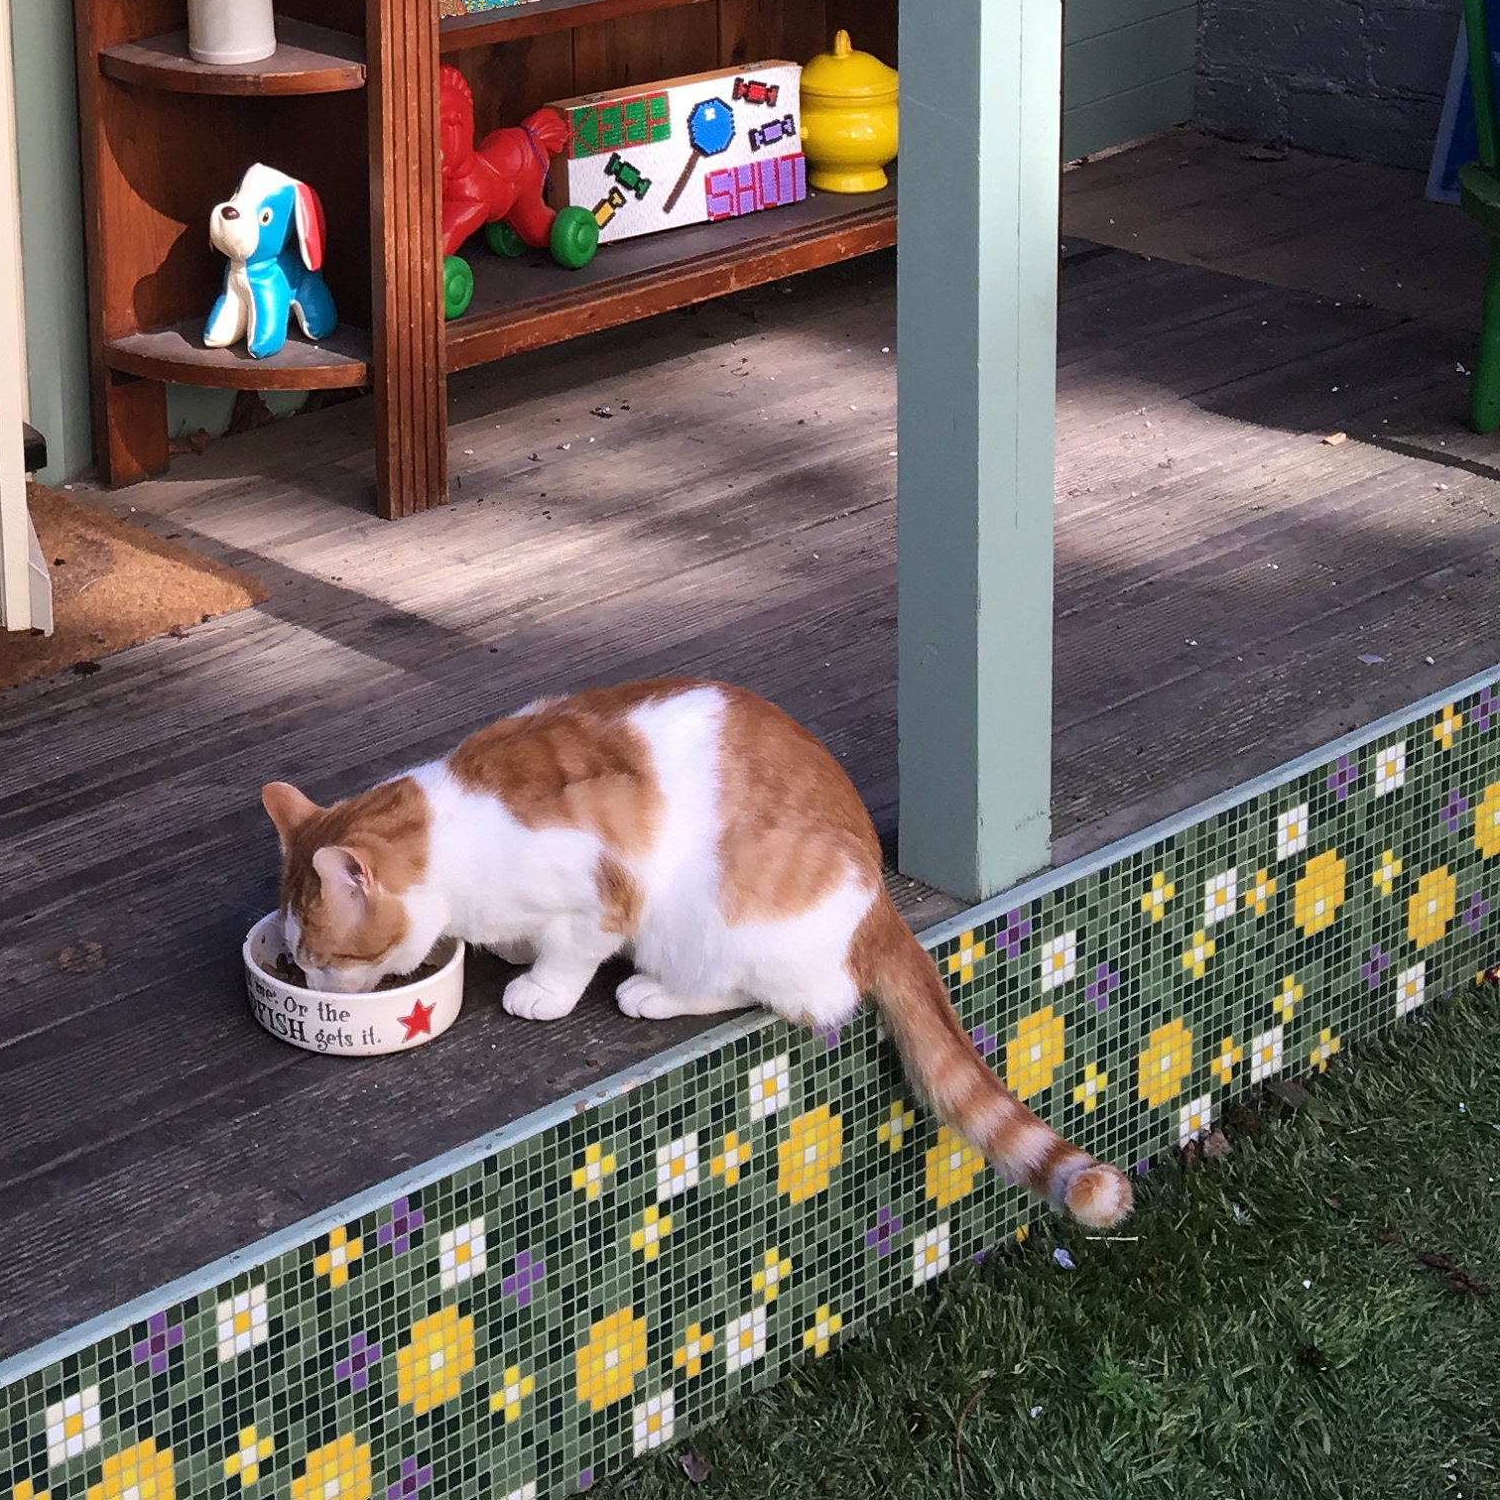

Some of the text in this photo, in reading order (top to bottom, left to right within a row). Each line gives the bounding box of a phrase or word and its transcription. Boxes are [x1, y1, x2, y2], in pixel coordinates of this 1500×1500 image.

[566, 91, 670, 160] KEEP
[705, 151, 805, 221] SHUT
[251, 991, 382, 1052] FISH gets it.
[283, 996, 309, 1018] Or
[317, 1001, 351, 1022] the
